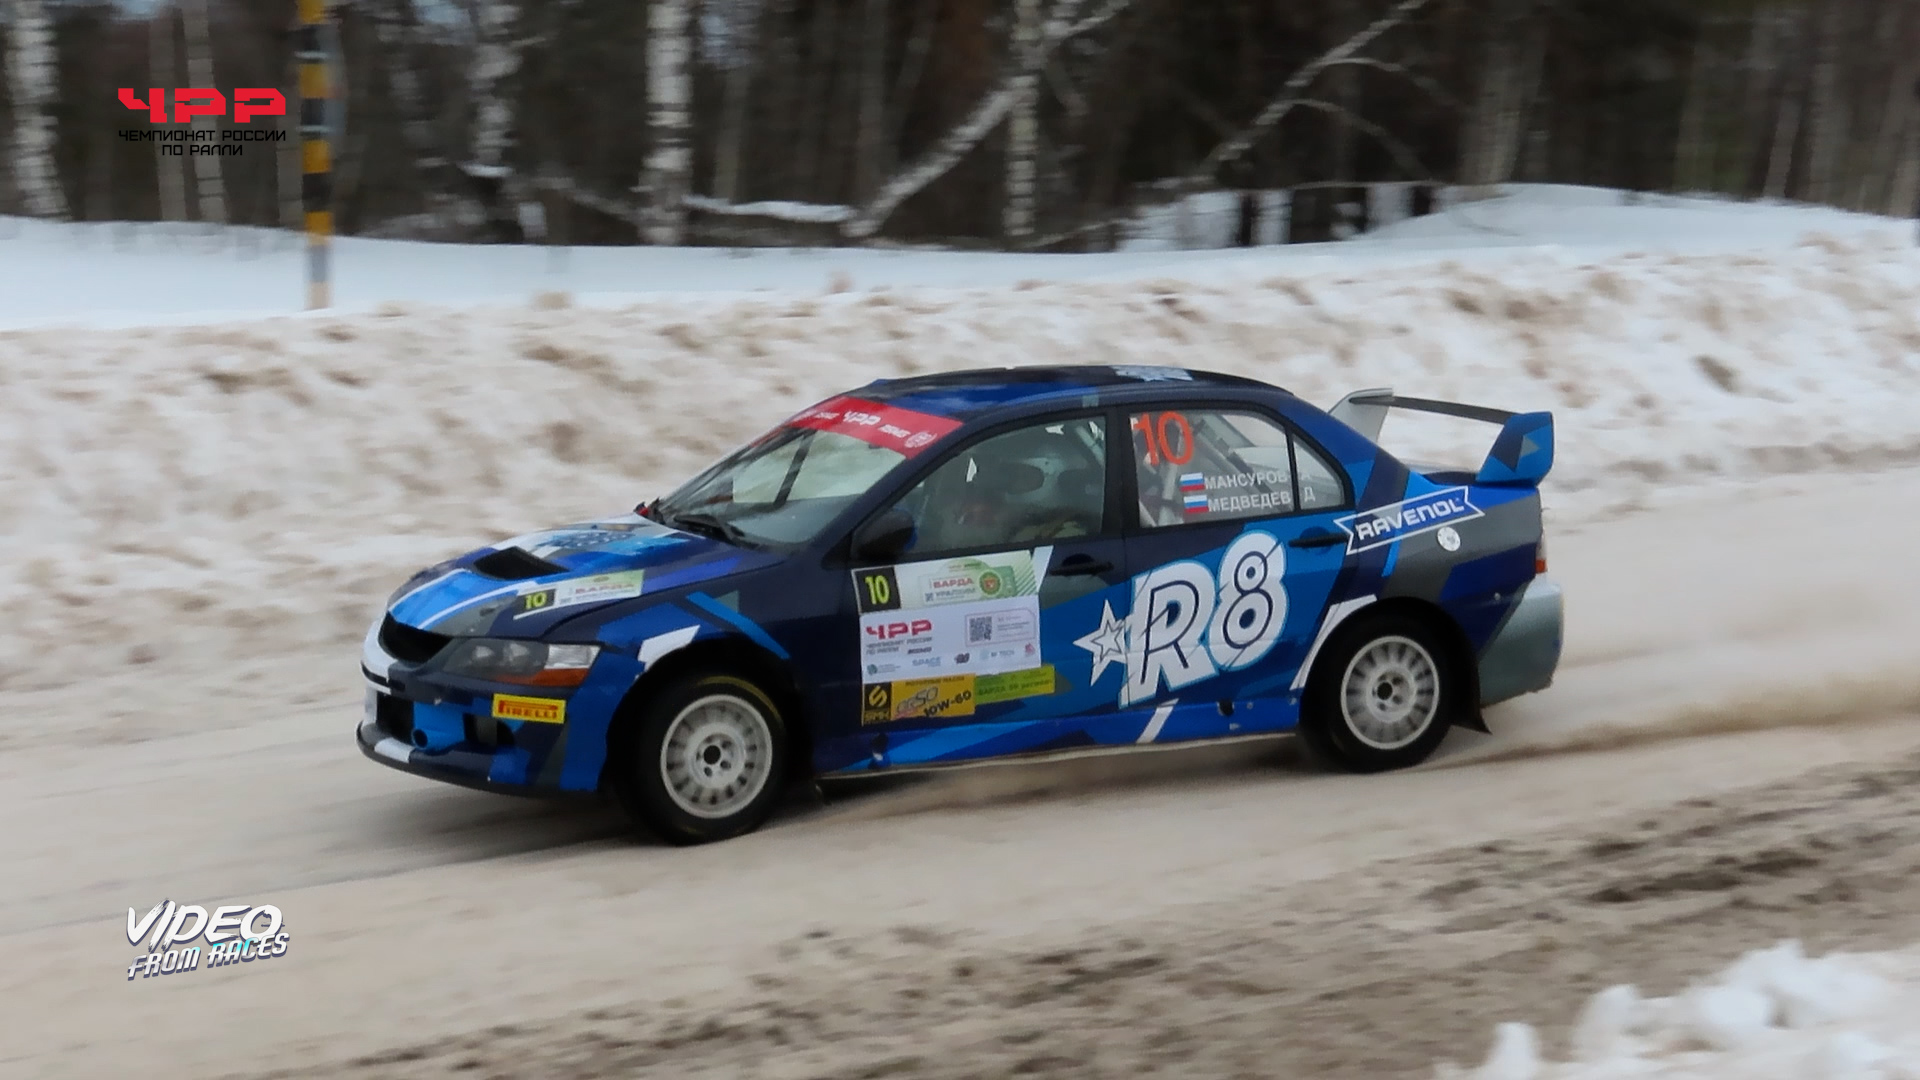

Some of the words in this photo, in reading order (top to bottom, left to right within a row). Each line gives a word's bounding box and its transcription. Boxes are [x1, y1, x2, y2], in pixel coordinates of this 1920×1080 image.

[1133, 410, 1194, 466] 10
[1204, 469, 1287, 490] МАНСУРОВ
[1208, 490, 1292, 512] МЕДВЕДЕВ
[1303, 486, 1316, 502] Д
[1355, 498, 1465, 541] RAVENOL
[524, 591, 548, 610] 10
[865, 575, 890, 605] 10
[866, 619, 932, 640] ЧРР
[1118, 529, 1288, 708] R8
[497, 700, 558, 720] PIRELLI
